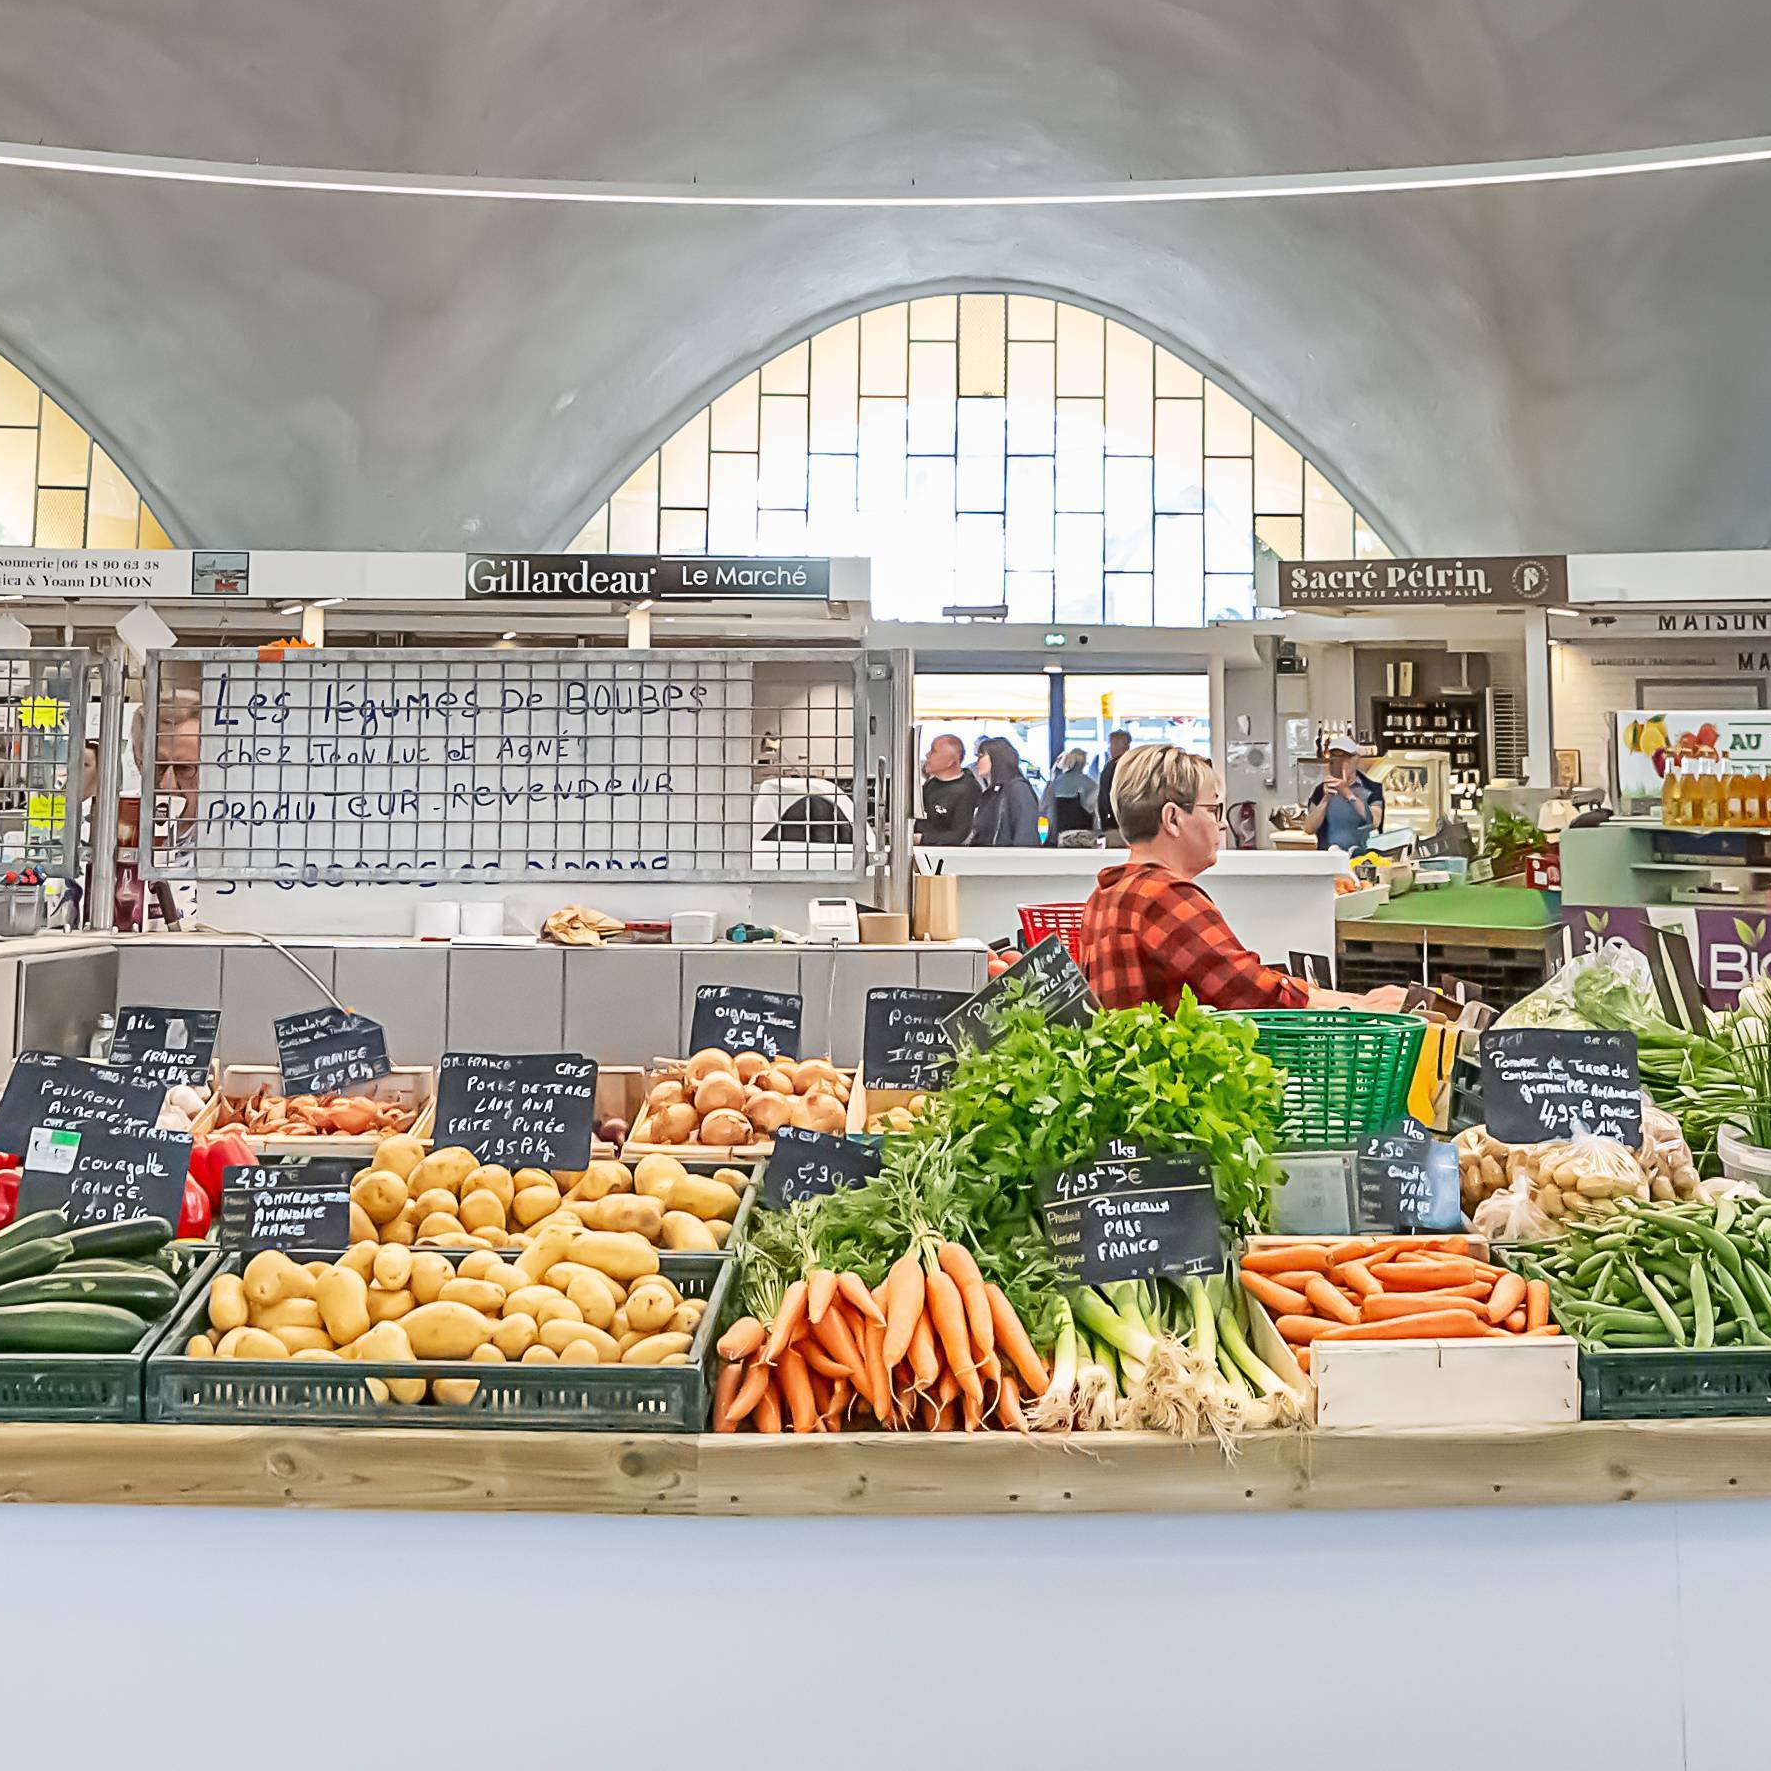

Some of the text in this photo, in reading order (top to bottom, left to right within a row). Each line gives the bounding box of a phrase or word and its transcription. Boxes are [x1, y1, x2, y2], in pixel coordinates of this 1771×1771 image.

[25, 575, 36, 587] &
[42, 575, 85, 588] Yoann
[90, 576, 152, 589] DUMON
[468, 559, 650, 595] Gillardeau
[682, 564, 807, 587] Le Marché
[1291, 563, 1378, 589] Sacré
[1387, 561, 1492, 594] Pétrin
[1292, 589, 1478, 599] BOULANGERIE ARTISANALE
[215, 674, 291, 726] Les
[1729, 733, 1761, 750] AU
[1108, 1138, 1138, 1159] 1kg
